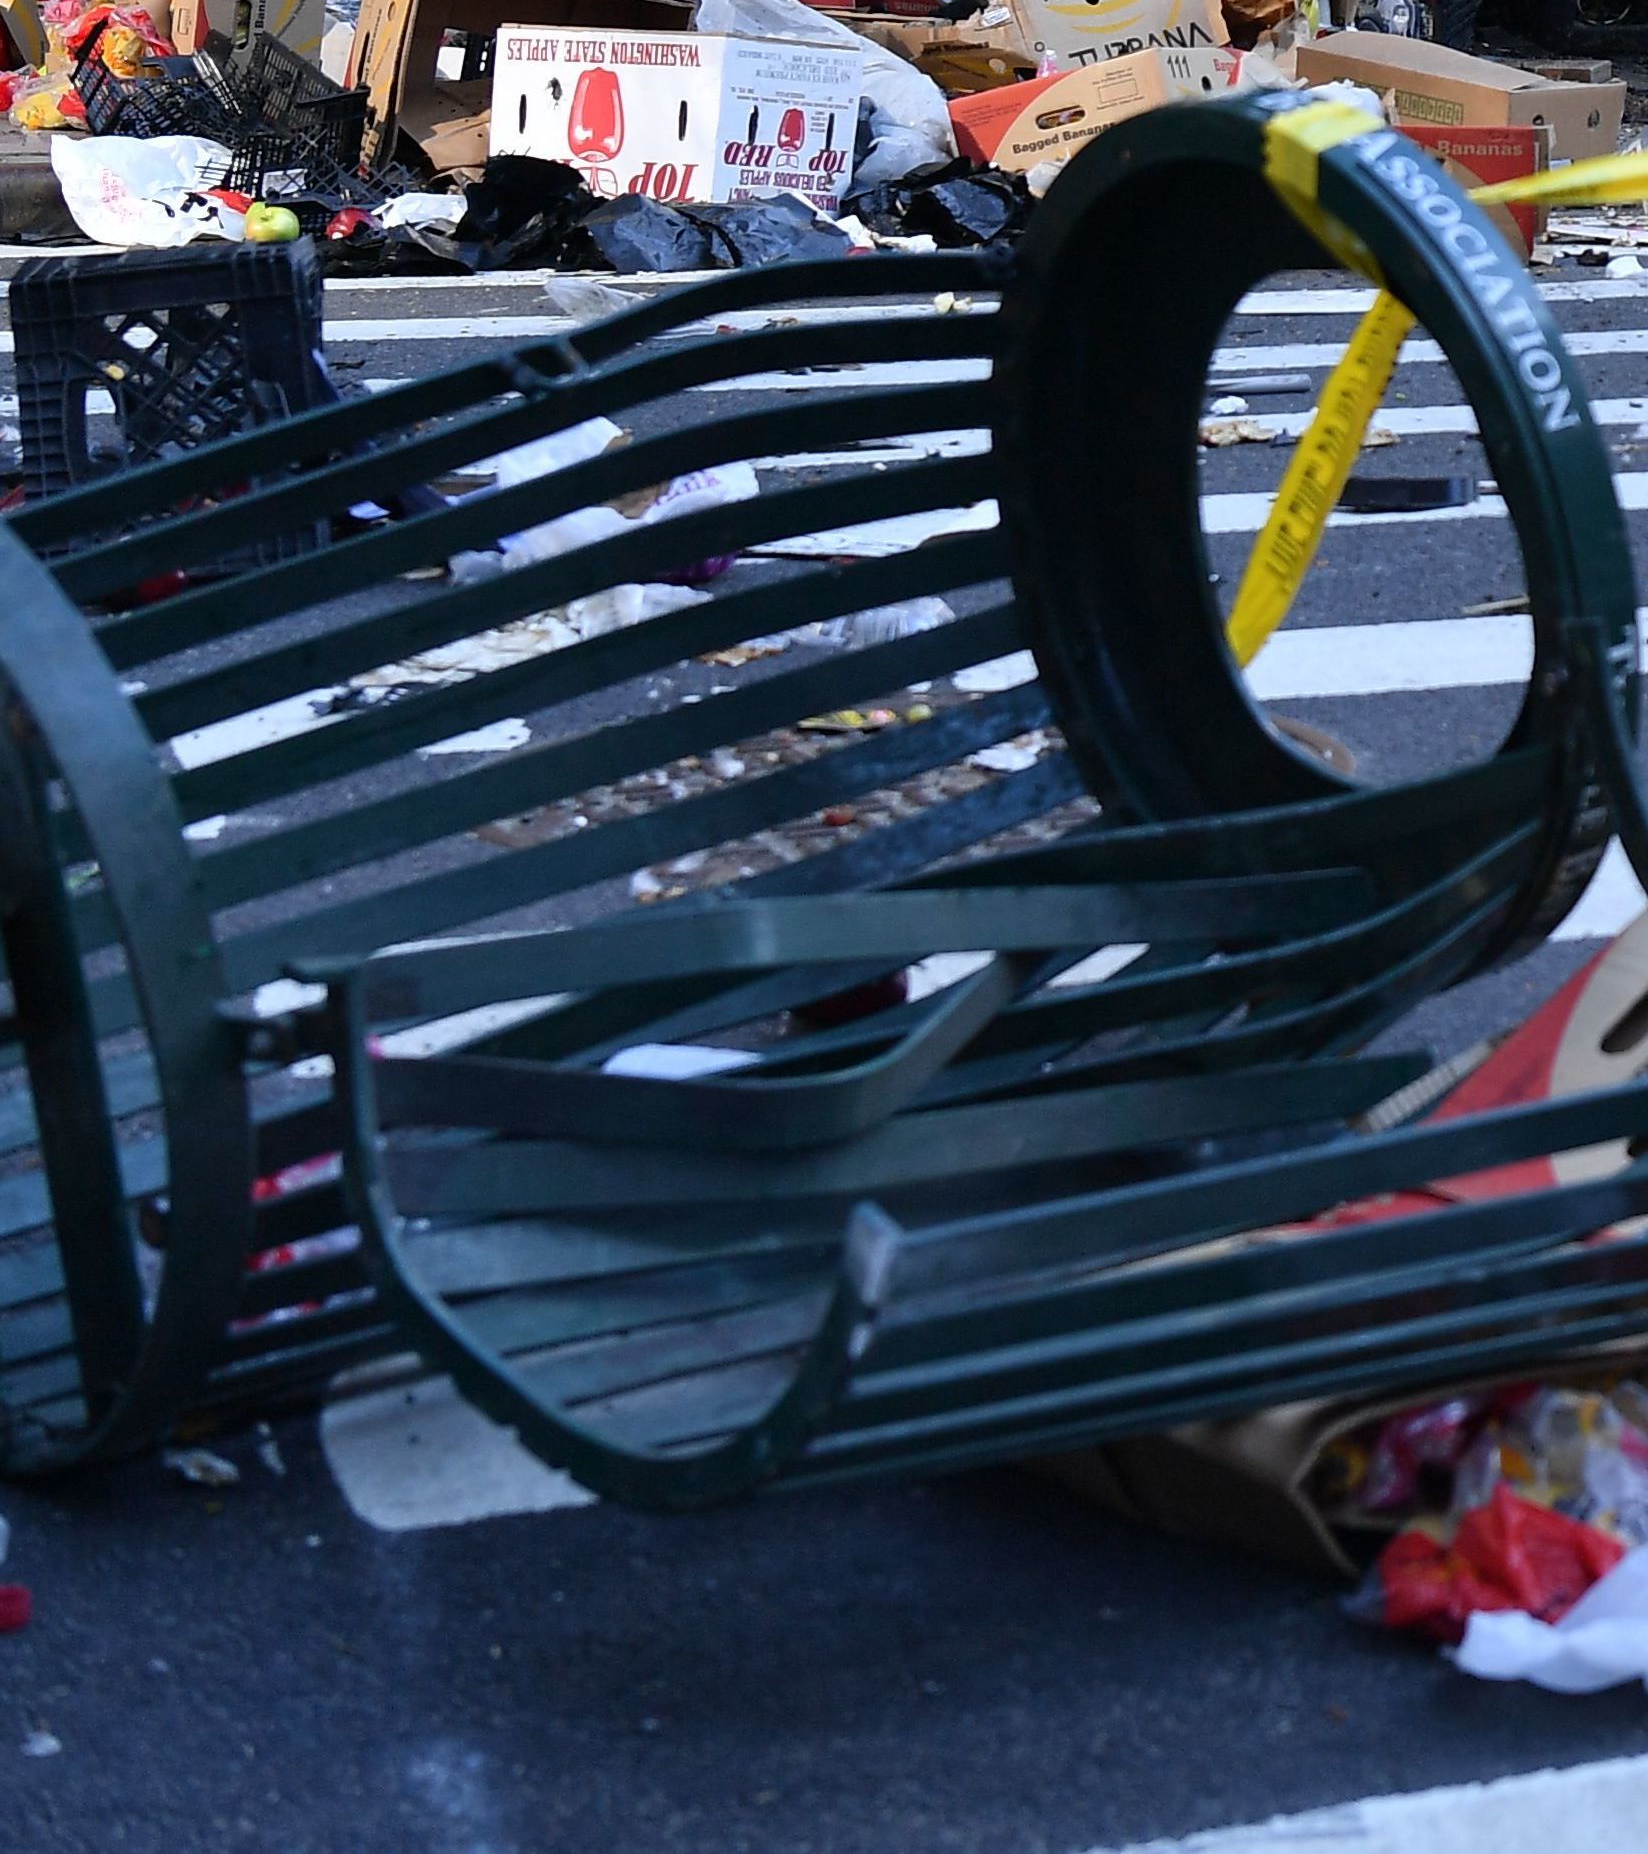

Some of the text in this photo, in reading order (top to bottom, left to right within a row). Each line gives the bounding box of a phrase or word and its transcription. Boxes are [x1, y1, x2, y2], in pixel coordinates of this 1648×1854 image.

[507, 38, 702, 67] WASHINGTON STATE APPLES
[1166, 54, 1193, 81] 111
[724, 141, 849, 173] TOP RED
[1012, 132, 1060, 156] Bagged
[1437, 140, 1524, 157] Bananas
[627, 161, 700, 202] TOP
[739, 169, 771, 188] APPLES
[1348, 131, 1583, 432] ASSOCIATION
